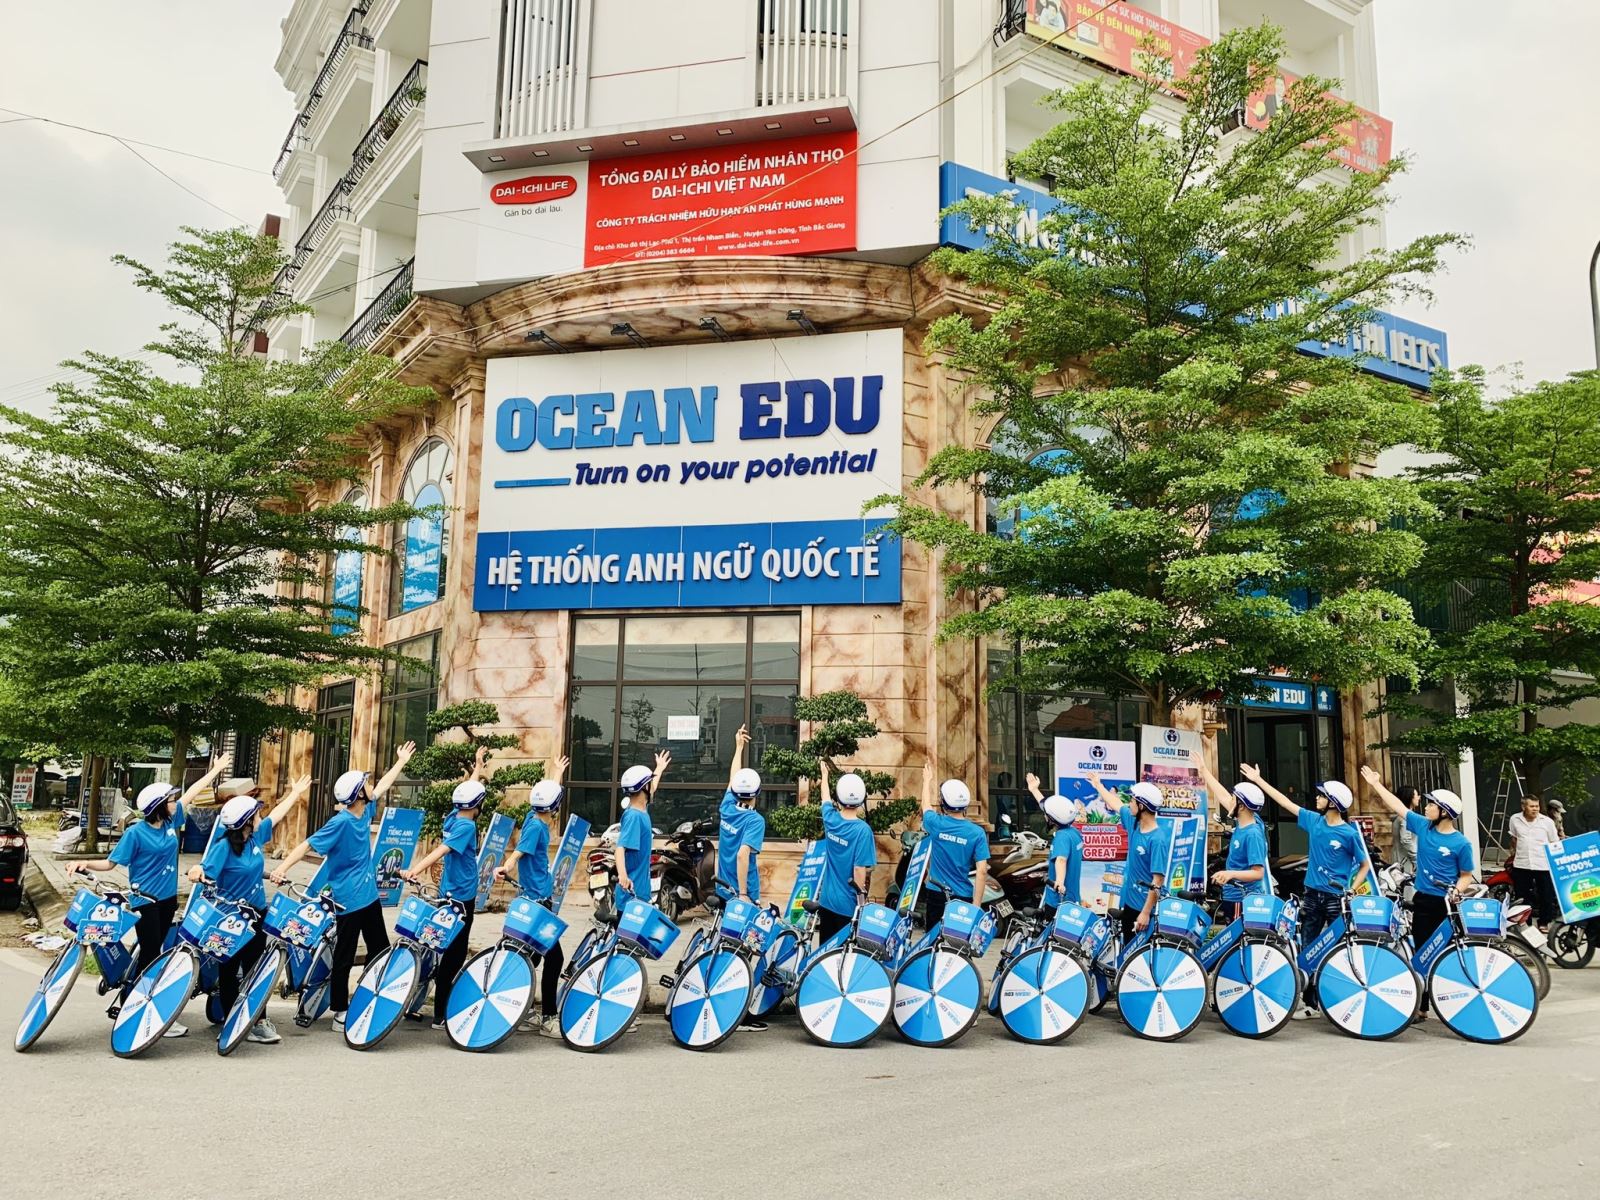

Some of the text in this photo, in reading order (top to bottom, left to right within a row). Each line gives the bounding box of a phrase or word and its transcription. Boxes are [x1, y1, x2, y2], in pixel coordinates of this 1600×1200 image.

[600, 148, 844, 187] TỔNG ĐẠI LÝ BẢO HIỂM NHÂN THỌ
[496, 180, 569, 198] DAI-ICHI LIFE
[652, 174, 785, 199] DAI-ICHI VIỆT NAM
[596, 196, 844, 228] CÔNG TY TRÁCH NHIỆM HỮU HẠN AN PHÁT HÙNG MẠNH
[1390, 330, 1442, 373] IELTS
[495, 374, 883, 452] OCEAN EDU
[575, 448, 877, 486] Turn on your potential
[488, 534, 884, 592] HỆ THỐNG ANH NGỮ QUỐC TẾ
[1283, 688, 1306, 704] EDU
[1153, 746, 1176, 756] OCEAN
[1078, 762, 1102, 770] OCEAN
[1082, 834, 1122, 845] UMMER
[1083, 847, 1116, 858] GREAT
[1567, 860, 1593, 872] 100%
[1200, 933, 1232, 960] OCEAN EDU
[1305, 933, 1334, 961] OCEAN EDU
[1420, 945, 1434, 964] OCEAN
